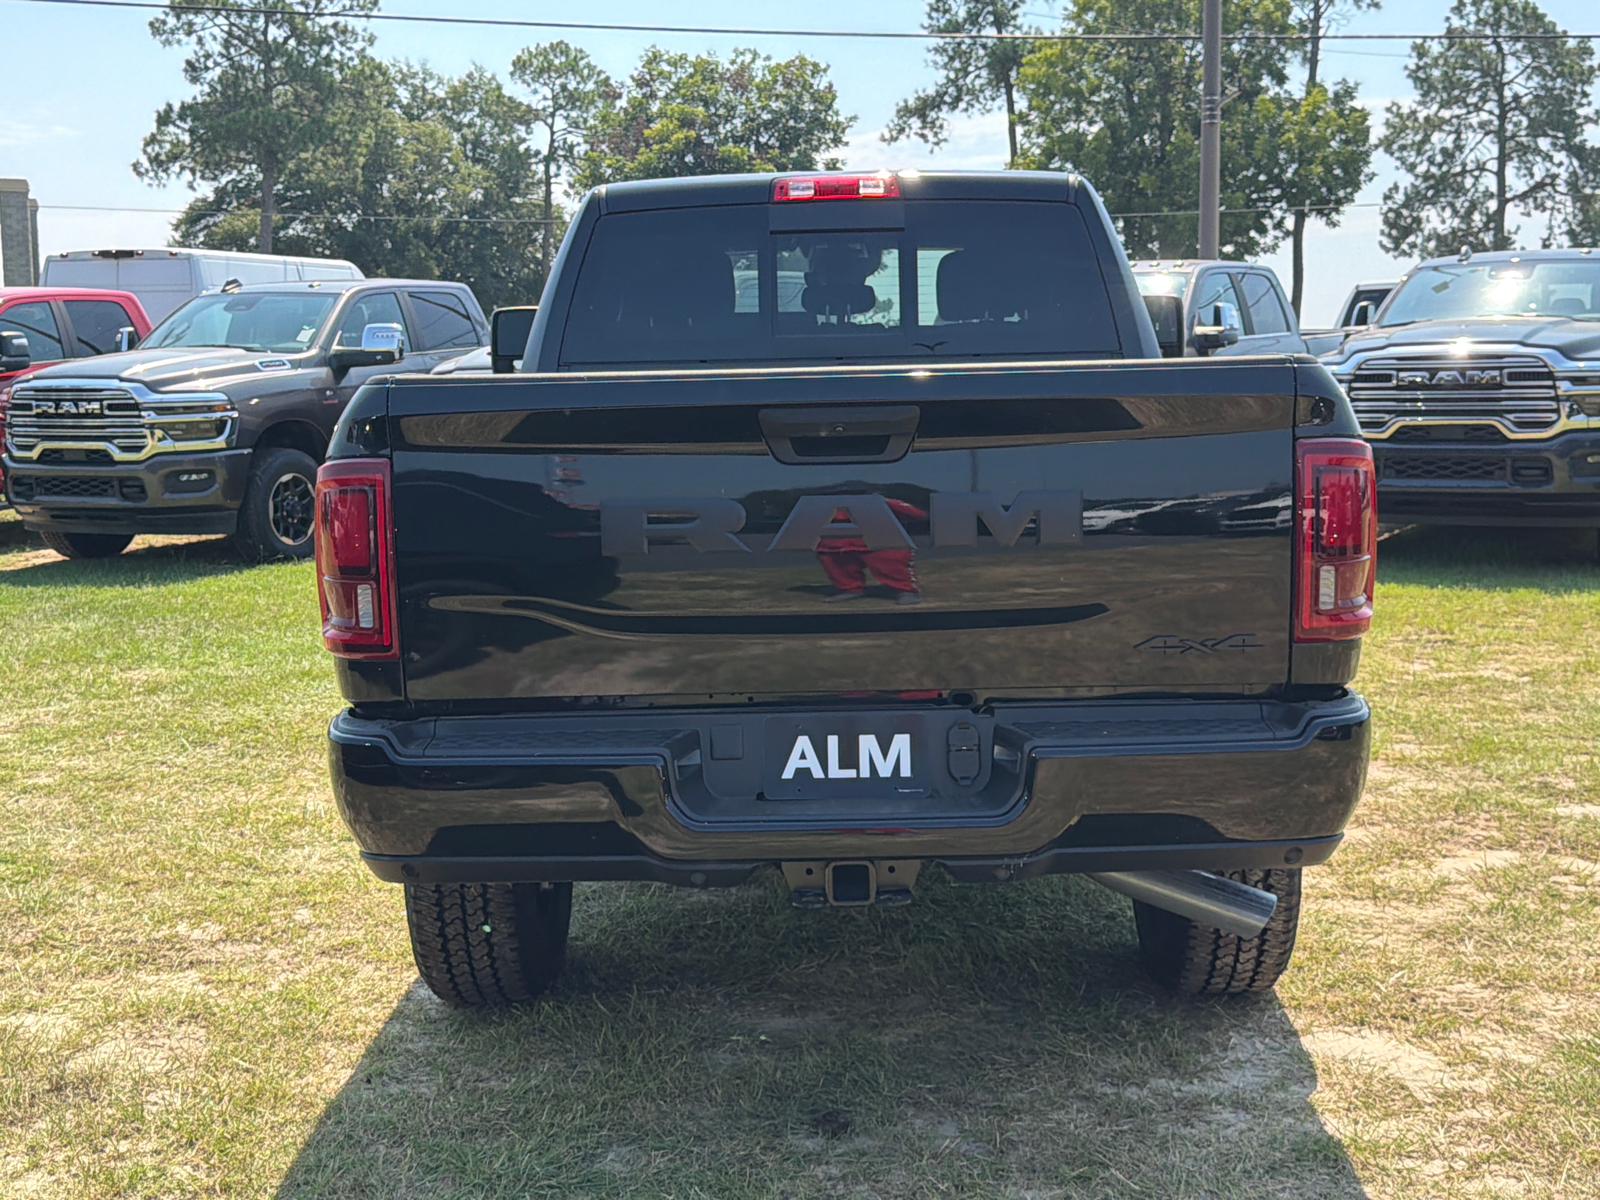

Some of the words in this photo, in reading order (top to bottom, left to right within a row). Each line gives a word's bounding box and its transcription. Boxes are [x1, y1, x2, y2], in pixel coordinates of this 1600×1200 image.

[1397, 370, 1501, 385] RAM
[34, 401, 101, 414] RAM
[600, 489, 1084, 557] RAM
[780, 733, 913, 780] ALM
